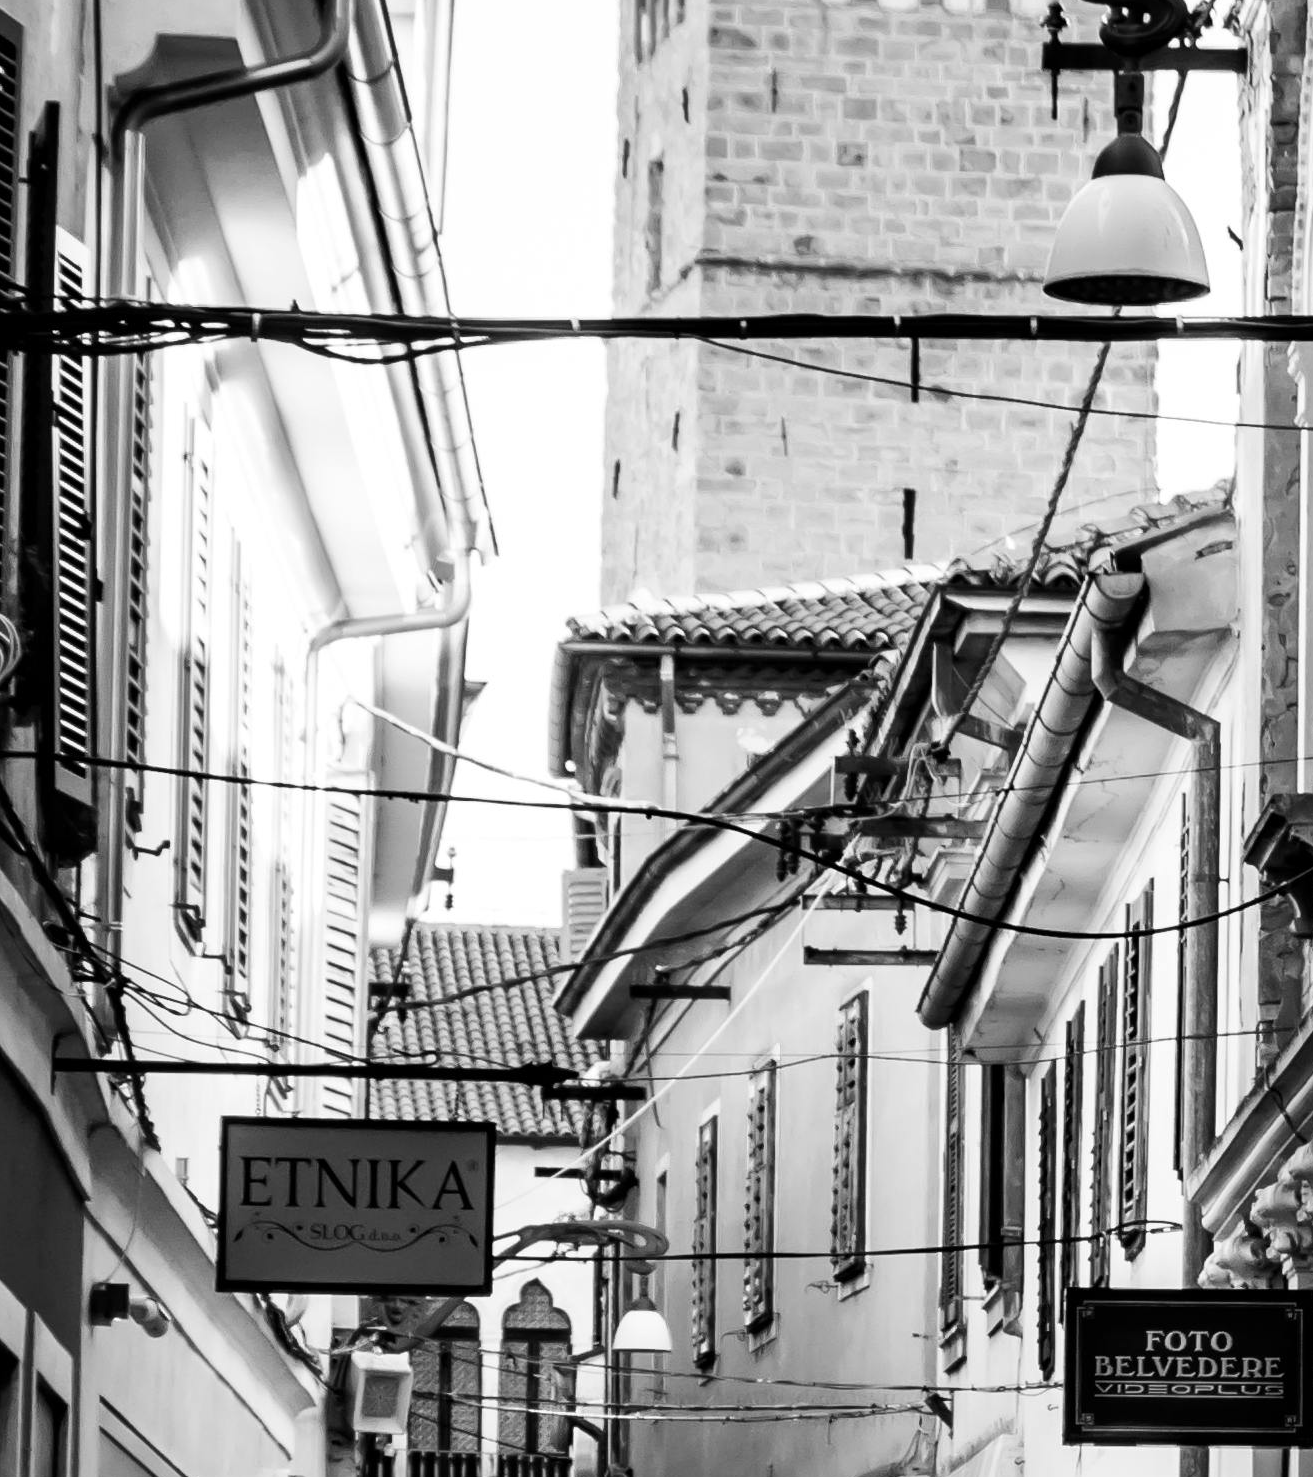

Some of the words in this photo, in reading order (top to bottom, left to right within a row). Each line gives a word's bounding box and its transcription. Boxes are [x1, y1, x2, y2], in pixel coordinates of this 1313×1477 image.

[238, 1156, 475, 1210] ETNIKA
[309, 1223, 365, 1242] SLOG
[1144, 1329, 1234, 1353] FOTO
[1094, 1354, 1286, 1379] BELVEDERE
[1094, 1383, 1285, 1396] VIDEOPLUS
